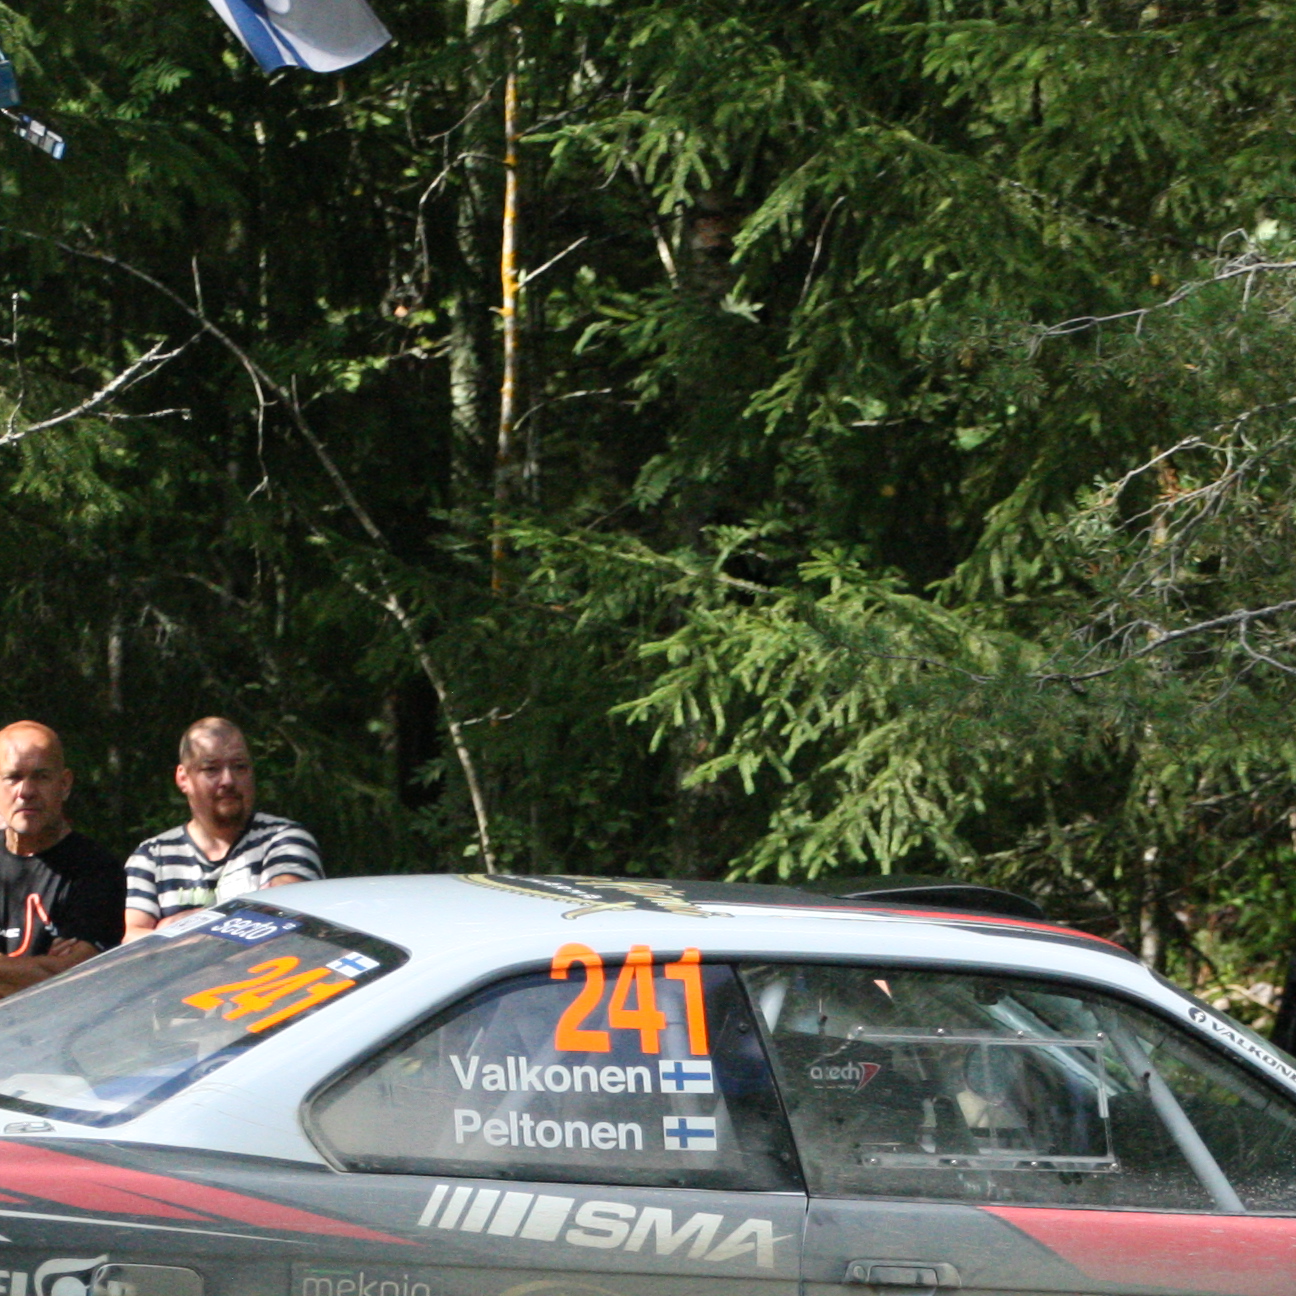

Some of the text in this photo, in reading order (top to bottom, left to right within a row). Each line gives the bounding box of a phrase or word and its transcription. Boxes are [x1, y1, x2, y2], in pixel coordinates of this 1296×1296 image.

[211, 917, 278, 940] secto
[181, 955, 357, 1034] 241
[550, 942, 710, 1056] 241
[449, 1054, 653, 1093] Valkonen
[809, 1061, 861, 1080] aech
[453, 1108, 644, 1151] Peltonen
[565, 1200, 792, 1268] SMA
